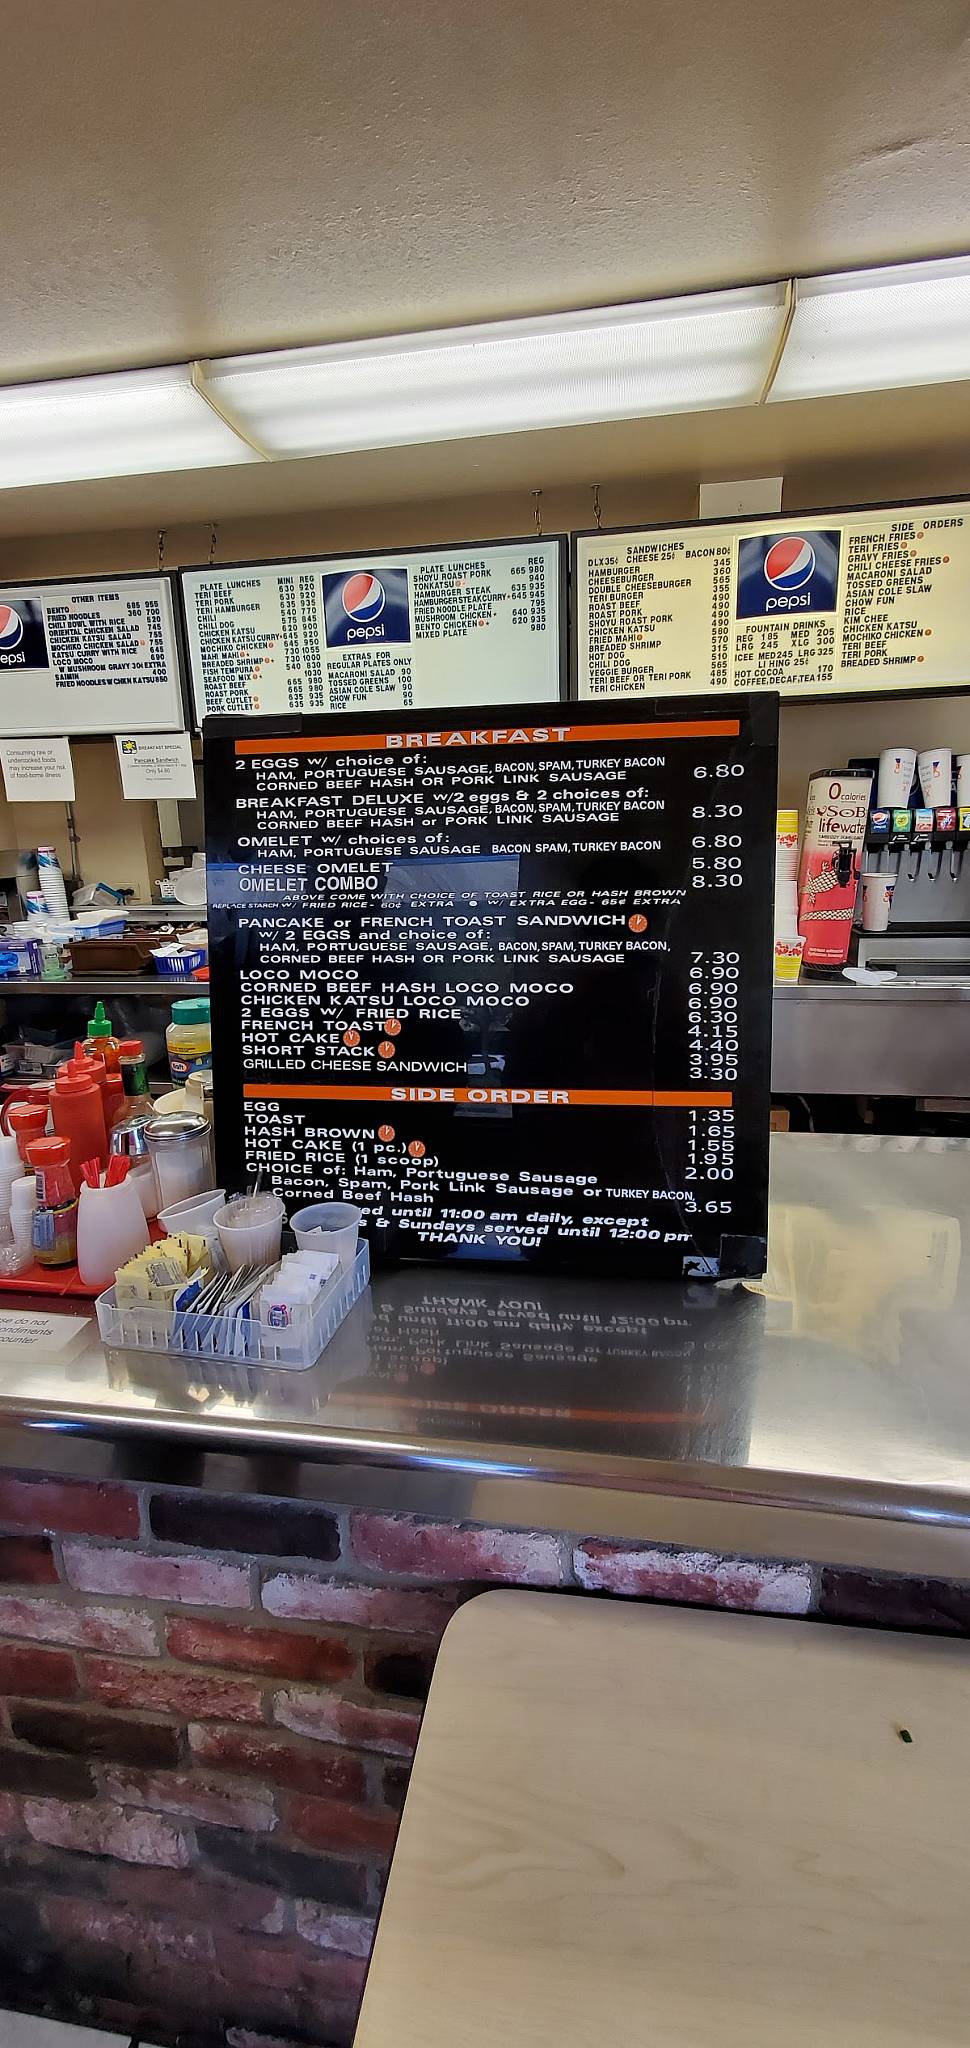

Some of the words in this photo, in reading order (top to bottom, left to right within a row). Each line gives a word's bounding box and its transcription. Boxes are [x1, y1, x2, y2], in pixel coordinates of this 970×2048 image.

[891, 523, 914, 532] SIDE
[923, 519, 963, 530] ORDERS
[627, 543, 684, 554] SANDWICHES
[448, 562, 485, 571] LUNCHES
[528, 557, 544, 565] REG
[589, 567, 640, 576] HAMBURGER
[713, 559, 731, 567] 345
[847, 563, 871, 572] CHILI
[876, 560, 911, 570] CHEESE
[915, 557, 941, 566] FRIES
[414, 574, 438, 582] SHOYU
[847, 569, 896, 580] MACARONI
[901, 567, 932, 576] SALAD
[200, 583, 222, 591] PLATE
[227, 580, 261, 588] LUNCHES
[589, 585, 621, 594] DOUBLE
[626, 579, 691, 591] CHEESEBURGER
[713, 576, 730, 584] 565
[846, 588, 874, 598] ASIAN
[878, 587, 902, 596] COLE
[906, 585, 932, 594] SLAW
[72, 594, 94, 603] OTHER
[415, 590, 461, 598] HAMBURGER
[766, 592, 811, 611] pepsi
[196, 607, 213, 615] TERI
[215, 604, 260, 613] HAMBURGER
[300, 599, 316, 607] 935
[49, 628, 81, 636] ORIENTAL
[84, 626, 114, 635] CHICKEN
[347, 623, 385, 641] pepsi
[746, 623, 790, 633] FOUNTAIN
[793, 620, 826, 630] DRINKS
[736, 635, 753, 643] REG
[762, 633, 778, 641] 185
[817, 628, 834, 636] 205
[363, 659, 391, 668] PLATES
[394, 658, 411, 666] ONLY
[386, 728, 571, 749] BREAKFAST
[235, 760, 245, 770] 2
[252, 759, 299, 768] EGGS
[308, 757, 328, 766] w/
[336, 755, 394, 766] choice
[403, 754, 427, 764] of:
[694, 764, 744, 778] 6.80
[236, 796, 342, 808] BREAKFAST
[352, 794, 424, 806] DELUXE
[470, 793, 509, 803] eggs
[516, 790, 530, 801] &
[538, 790, 547, 800] 2
[553, 789, 620, 800] choices
[627, 788, 649, 798] of:
[829, 783, 841, 800] 0
[692, 805, 743, 818] 8.30
[819, 818, 865, 833] lifewate
[238, 836, 312, 847] OMELET
[321, 836, 341, 846] w/
[348, 834, 416, 844] choices
[426, 833, 450, 843] of:
[692, 835, 742, 848] 6.80
[238, 864, 306, 874] CHEESE
[317, 863, 393, 873] OMELET
[692, 857, 742, 870] 5.80
[240, 878, 308, 891] OMELET
[315, 876, 378, 890] COMBO
[692, 874, 743, 888] 8.30
[239, 918, 324, 928] PANCAKE
[334, 919, 351, 927] or
[361, 917, 432, 927] FRENCH
[443, 916, 506, 926] TOAST
[517, 916, 626, 925] SANDWICH
[240, 970, 290, 979] LOCO
[300, 970, 359, 979] MOCO
[689, 968, 739, 979] 6.90
[241, 995, 321, 1005] CHICKEN
[330, 996, 394, 1005] KATSU
[404, 996, 456, 1006] LOCO
[467, 996, 530, 1006] MOCO
[688, 997, 737, 1009] 6.90
[242, 1020, 313, 1030] FRENCH
[323, 1021, 384, 1030] TOAST
[688, 1025, 737, 1038] 4.15
[243, 1045, 304, 1055] SHORT
[315, 1046, 375, 1056] STACK
[689, 1054, 737, 1066] 3.95
[391, 1088, 455, 1101] SIDE
[468, 1090, 569, 1104] ORDER
[244, 1102, 279, 1112] EGG
[689, 1110, 734, 1121] 1.35
[244, 1115, 305, 1124] TOAST
[689, 1126, 734, 1138] 1.65
[245, 1127, 295, 1136] HASH
[305, 1128, 374, 1138] BROWN
[688, 1140, 734, 1152] 1.55
[376, 1218, 390, 1227] &
[399, 1219, 475, 1232] Sundays
[484, 1223, 548, 1235] served
[558, 1226, 600, 1237] until
[610, 1228, 660, 1240] 12:00
[418, 1232, 485, 1245] THANK
[496, 1236, 541, 1247] YOU!
[0, 1326, 53, 1335] ondiments
